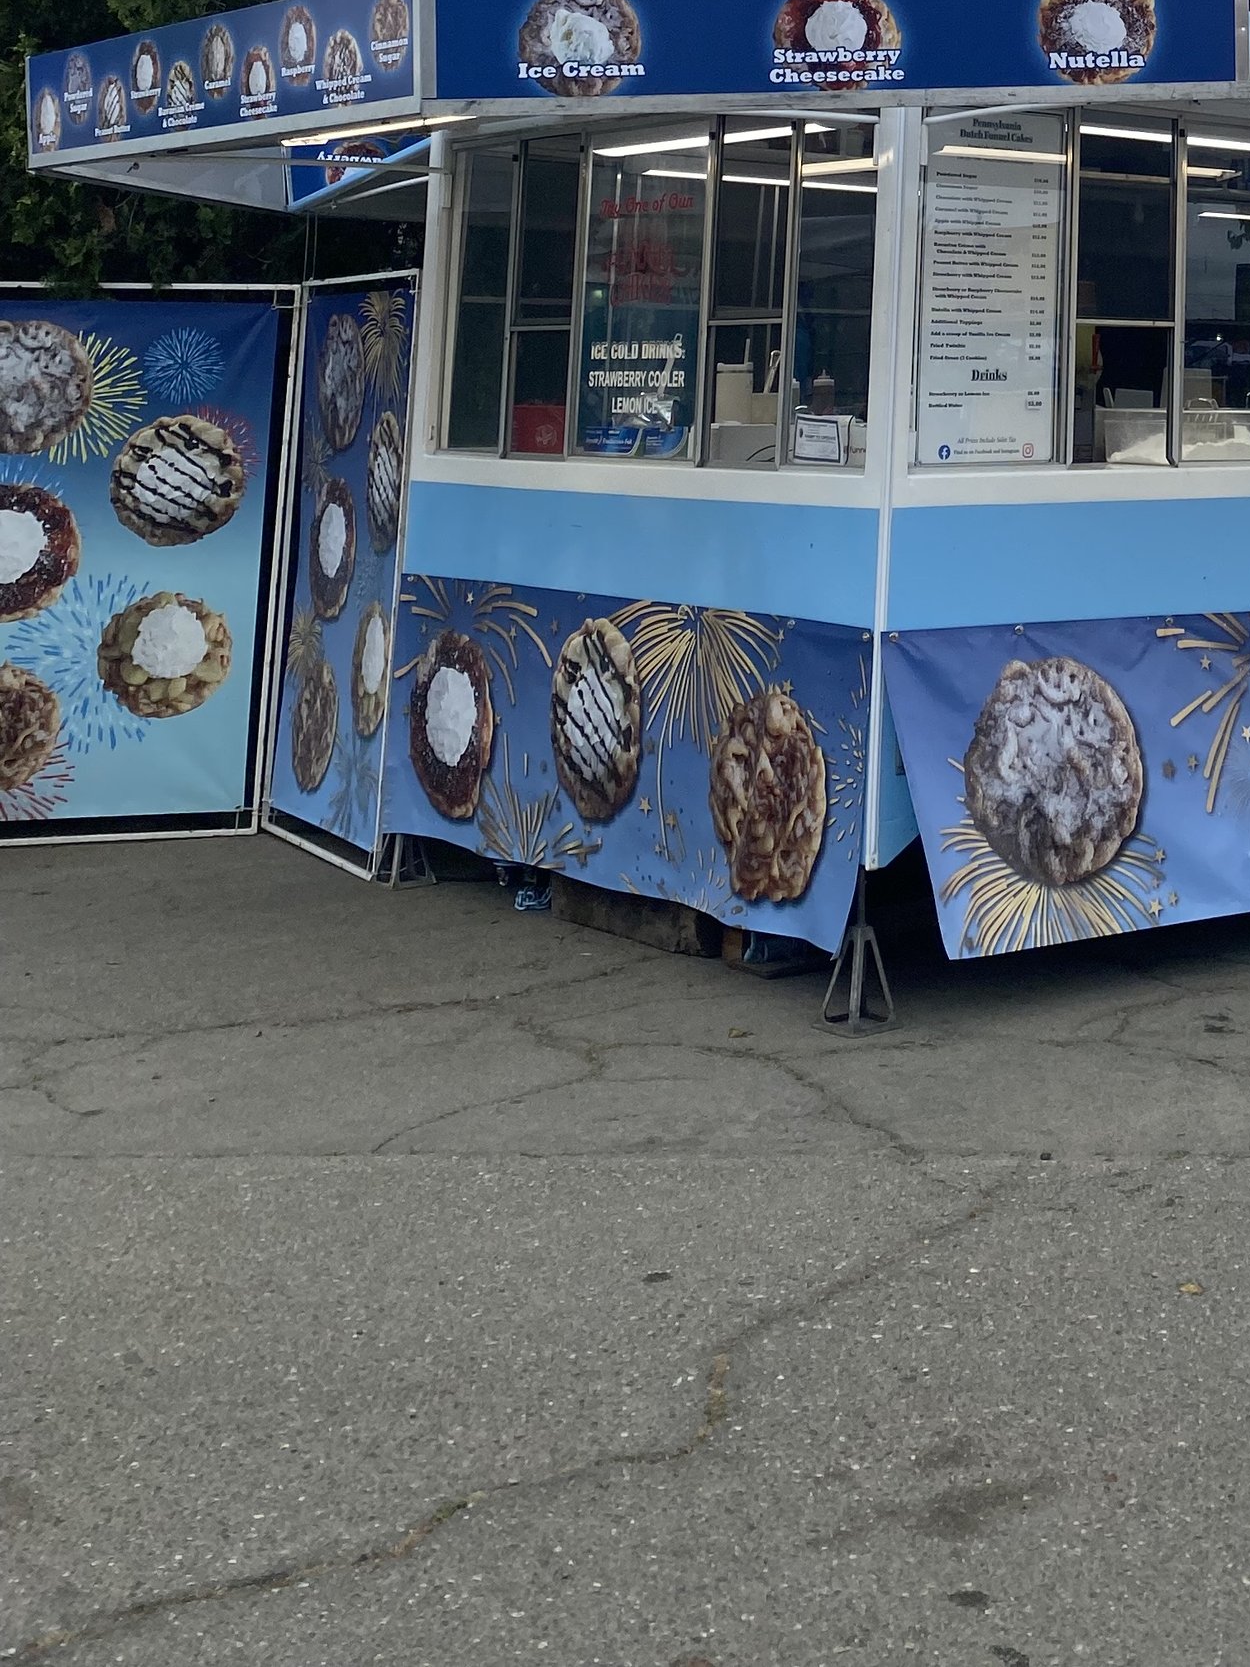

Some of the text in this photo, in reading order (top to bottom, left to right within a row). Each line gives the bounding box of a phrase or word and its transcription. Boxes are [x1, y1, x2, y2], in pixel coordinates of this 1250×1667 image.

[371, 38, 408, 51] Cinnamon
[379, 52, 400, 63] Sugar
[773, 48, 901, 64] Strawberry
[1048, 51, 1145, 71] Nutella
[281, 64, 315, 77] Raspberry
[518, 61, 645, 78] Ice Cream
[769, 67, 904, 83] Cheesecake
[204, 78, 231, 90] Caramel
[315, 74, 372, 91] Whipped Cream
[241, 92, 276, 104] Strawberry
[322, 90, 365, 105] & Chocolate
[240, 104, 278, 117] Cheesecake
[162, 119, 167, 128] &
[973, 118, 1021, 131] Pennsylvania
[960, 129, 1033, 143] Dutch Funnel Cakes
[591, 342, 608, 360] ICE
[611, 342, 639, 359] COLD
[588, 371, 685, 387] STRAWBERRY COOLER
[971, 369, 1007, 381] Drinks
[612, 397, 658, 413] LEMON ICE
